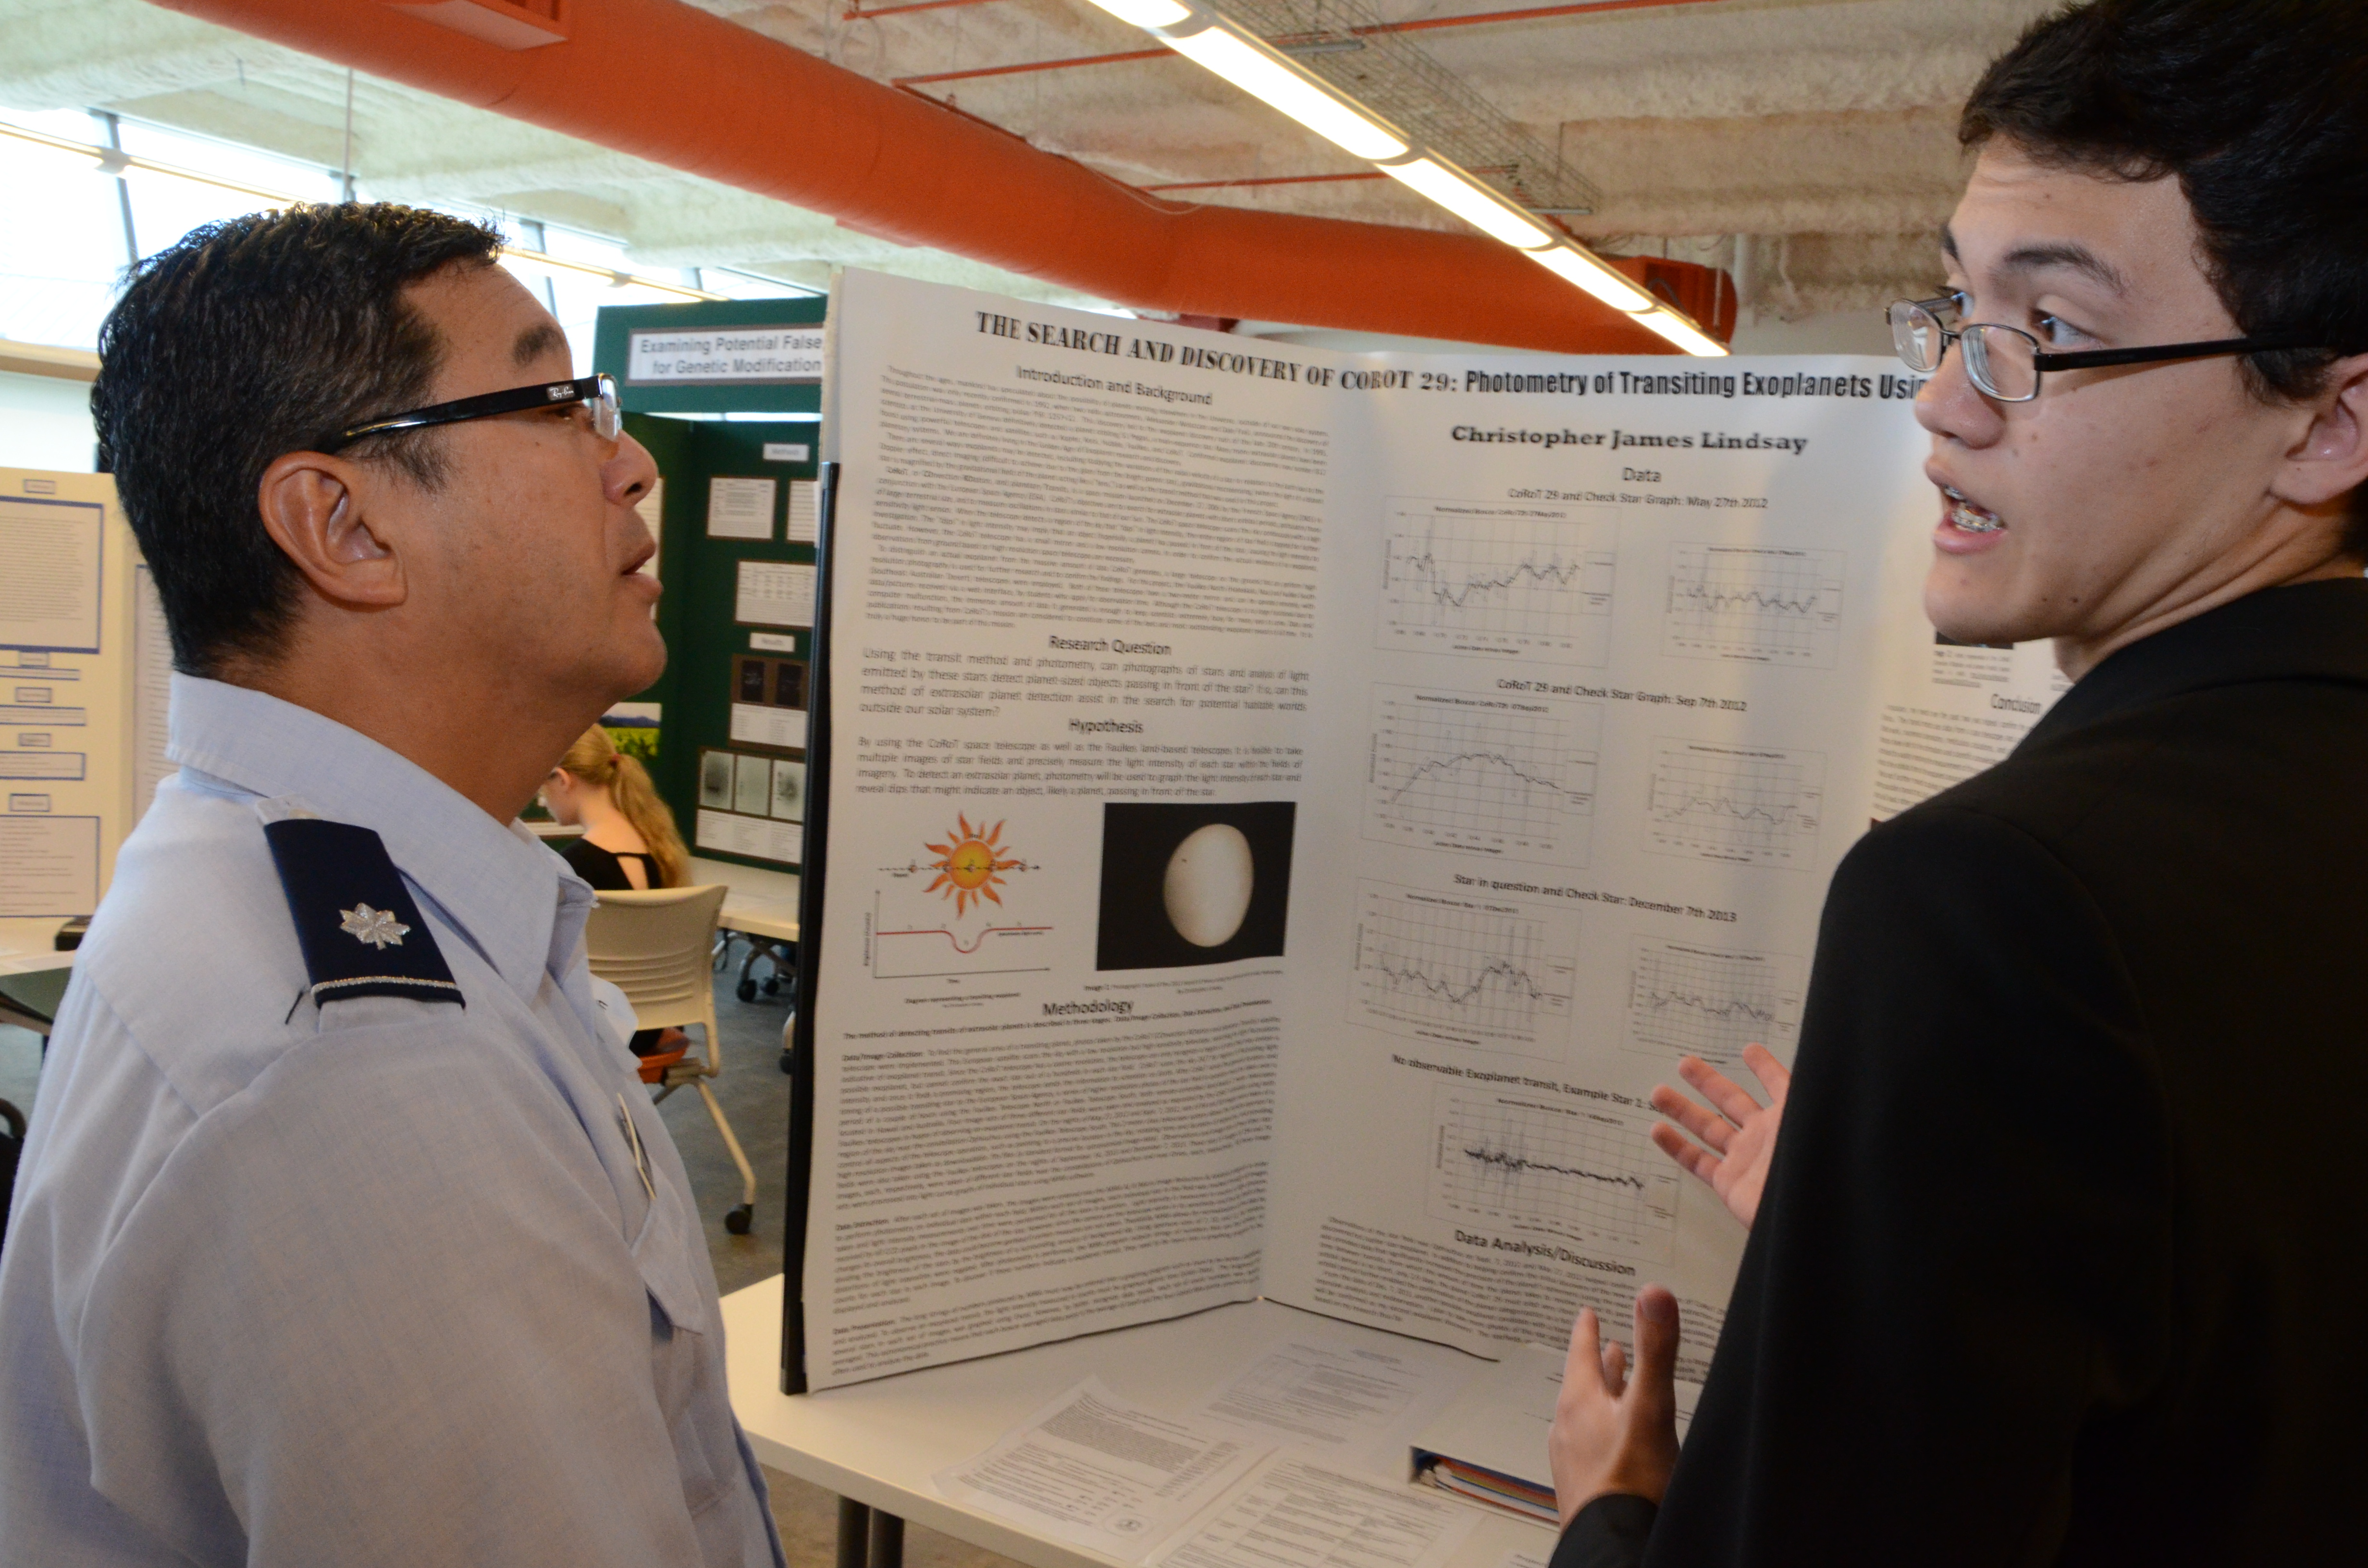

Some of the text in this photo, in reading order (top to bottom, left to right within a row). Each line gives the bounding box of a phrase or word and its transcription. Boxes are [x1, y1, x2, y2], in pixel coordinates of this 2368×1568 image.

[641, 335, 822, 355] Examining Potential False
[975, 311, 1021, 341] THE
[1026, 322, 1122, 355] SEARCH
[1128, 338, 1174, 363] AND
[1180, 345, 1302, 382] DISCOVERY
[1306, 365, 1335, 387] OF
[1419, 372, 1457, 392] 29:
[1465, 370, 1587, 396] Photometry
[1594, 371, 1615, 394] of
[1619, 371, 1735, 398] Transiting
[1742, 371, 1871, 399] Exoplanets
[654, 358, 822, 373] for Genetic Modification
[1016, 365, 1212, 405] Introduction and Background
[1451, 425, 1808, 455] Christopher James Lindsay
[1622, 466, 1662, 482] Data
[1562, 490, 1582, 501] and
[1585, 490, 1617, 503] Check
[1619, 493, 1641, 504] Star
[1646, 494, 1682, 507] Graph:
[1686, 496, 1711, 509] May
[1048, 635, 1172, 655] Research Question
[863, 647, 896, 662] Using
[901, 649, 920, 661] the
[925, 651, 962, 663] transit
[967, 654, 1008, 666] method
[1012, 656, 1033, 667] and
[1100, 662, 1118, 671] can
[1123, 662, 1183, 675] photographs
[1186, 665, 1199, 675] of
[1202, 666, 1225, 676] stars
[1229, 668, 1246, 678] and
[1290, 670, 1309, 682] light
[862, 666, 908, 678] emitted
[910, 668, 925, 681] by
[928, 669, 959, 681] these
[962, 671, 988, 682] stars
[991, 673, 1024, 684] detect
[1026, 674, 1085, 686] planet-sized
[1087, 677, 1122, 689] objects
[1125, 680, 1160, 691] passing
[1163, 680, 1172, 690] in
[1176, 680, 1200, 691] front
[1202, 682, 1214, 692] of
[1215, 683, 1231, 693] the
[1234, 684, 1253, 694] star?
[1292, 686, 1308, 696] this
[860, 685, 907, 696] method
[913, 685, 925, 697] of
[930, 687, 984, 699] extrasolar
[988, 690, 1023, 702] planet
[1025, 691, 1073, 702] detection
[1077, 694, 1103, 704] assist
[1109, 694, 1118, 704] in
[1122, 695, 1140, 705] the
[1143, 696, 1176, 707] search
[1179, 697, 1195, 707] for
[1199, 698, 1240, 710] potential
[1278, 700, 1307, 711] worlds
[1552, 684, 1571, 695] and
[1574, 686, 1609, 698] Check
[1611, 689, 1634, 700] Star
[1676, 695, 1697, 708] Sep
[1699, 697, 1717, 709] 7th
[1719, 699, 1747, 712] 2012
[1991, 693, 2042, 715] Conclusion
[859, 702, 1000, 718] outside our solar system?
[1068, 718, 1144, 735] Hypothesis
[858, 736, 1303, 756] By using the CoRoT space telescope well the Faulkes land-based telescopes take
[857, 753, 1219, 770] multiple images star fields and precisely measure light intensity each
[1453, 874, 1475, 886] Star
[1478, 876, 1489, 888] in
[1491, 880, 1538, 894] question
[1542, 884, 1562, 897] and
[1565, 886, 1600, 901] Check
[1628, 896, 1683, 914] December
[1685, 905, 1705, 918] 7th
[1706, 908, 1737, 923] 2013
[1042, 999, 1134, 1017] Methodology
[1393, 1054, 1406, 1066] No
[1408, 1058, 1464, 1077] observable
[1466, 1066, 1520, 1084] Exoplanet
[1522, 1076, 1562, 1093] transit,
[1563, 1083, 1609, 1100] Example
[1610, 1091, 1635, 1106] Star
[1455, 1229, 1488, 1247] Data
[1491, 1237, 1636, 1276] Analysis/Discussion
